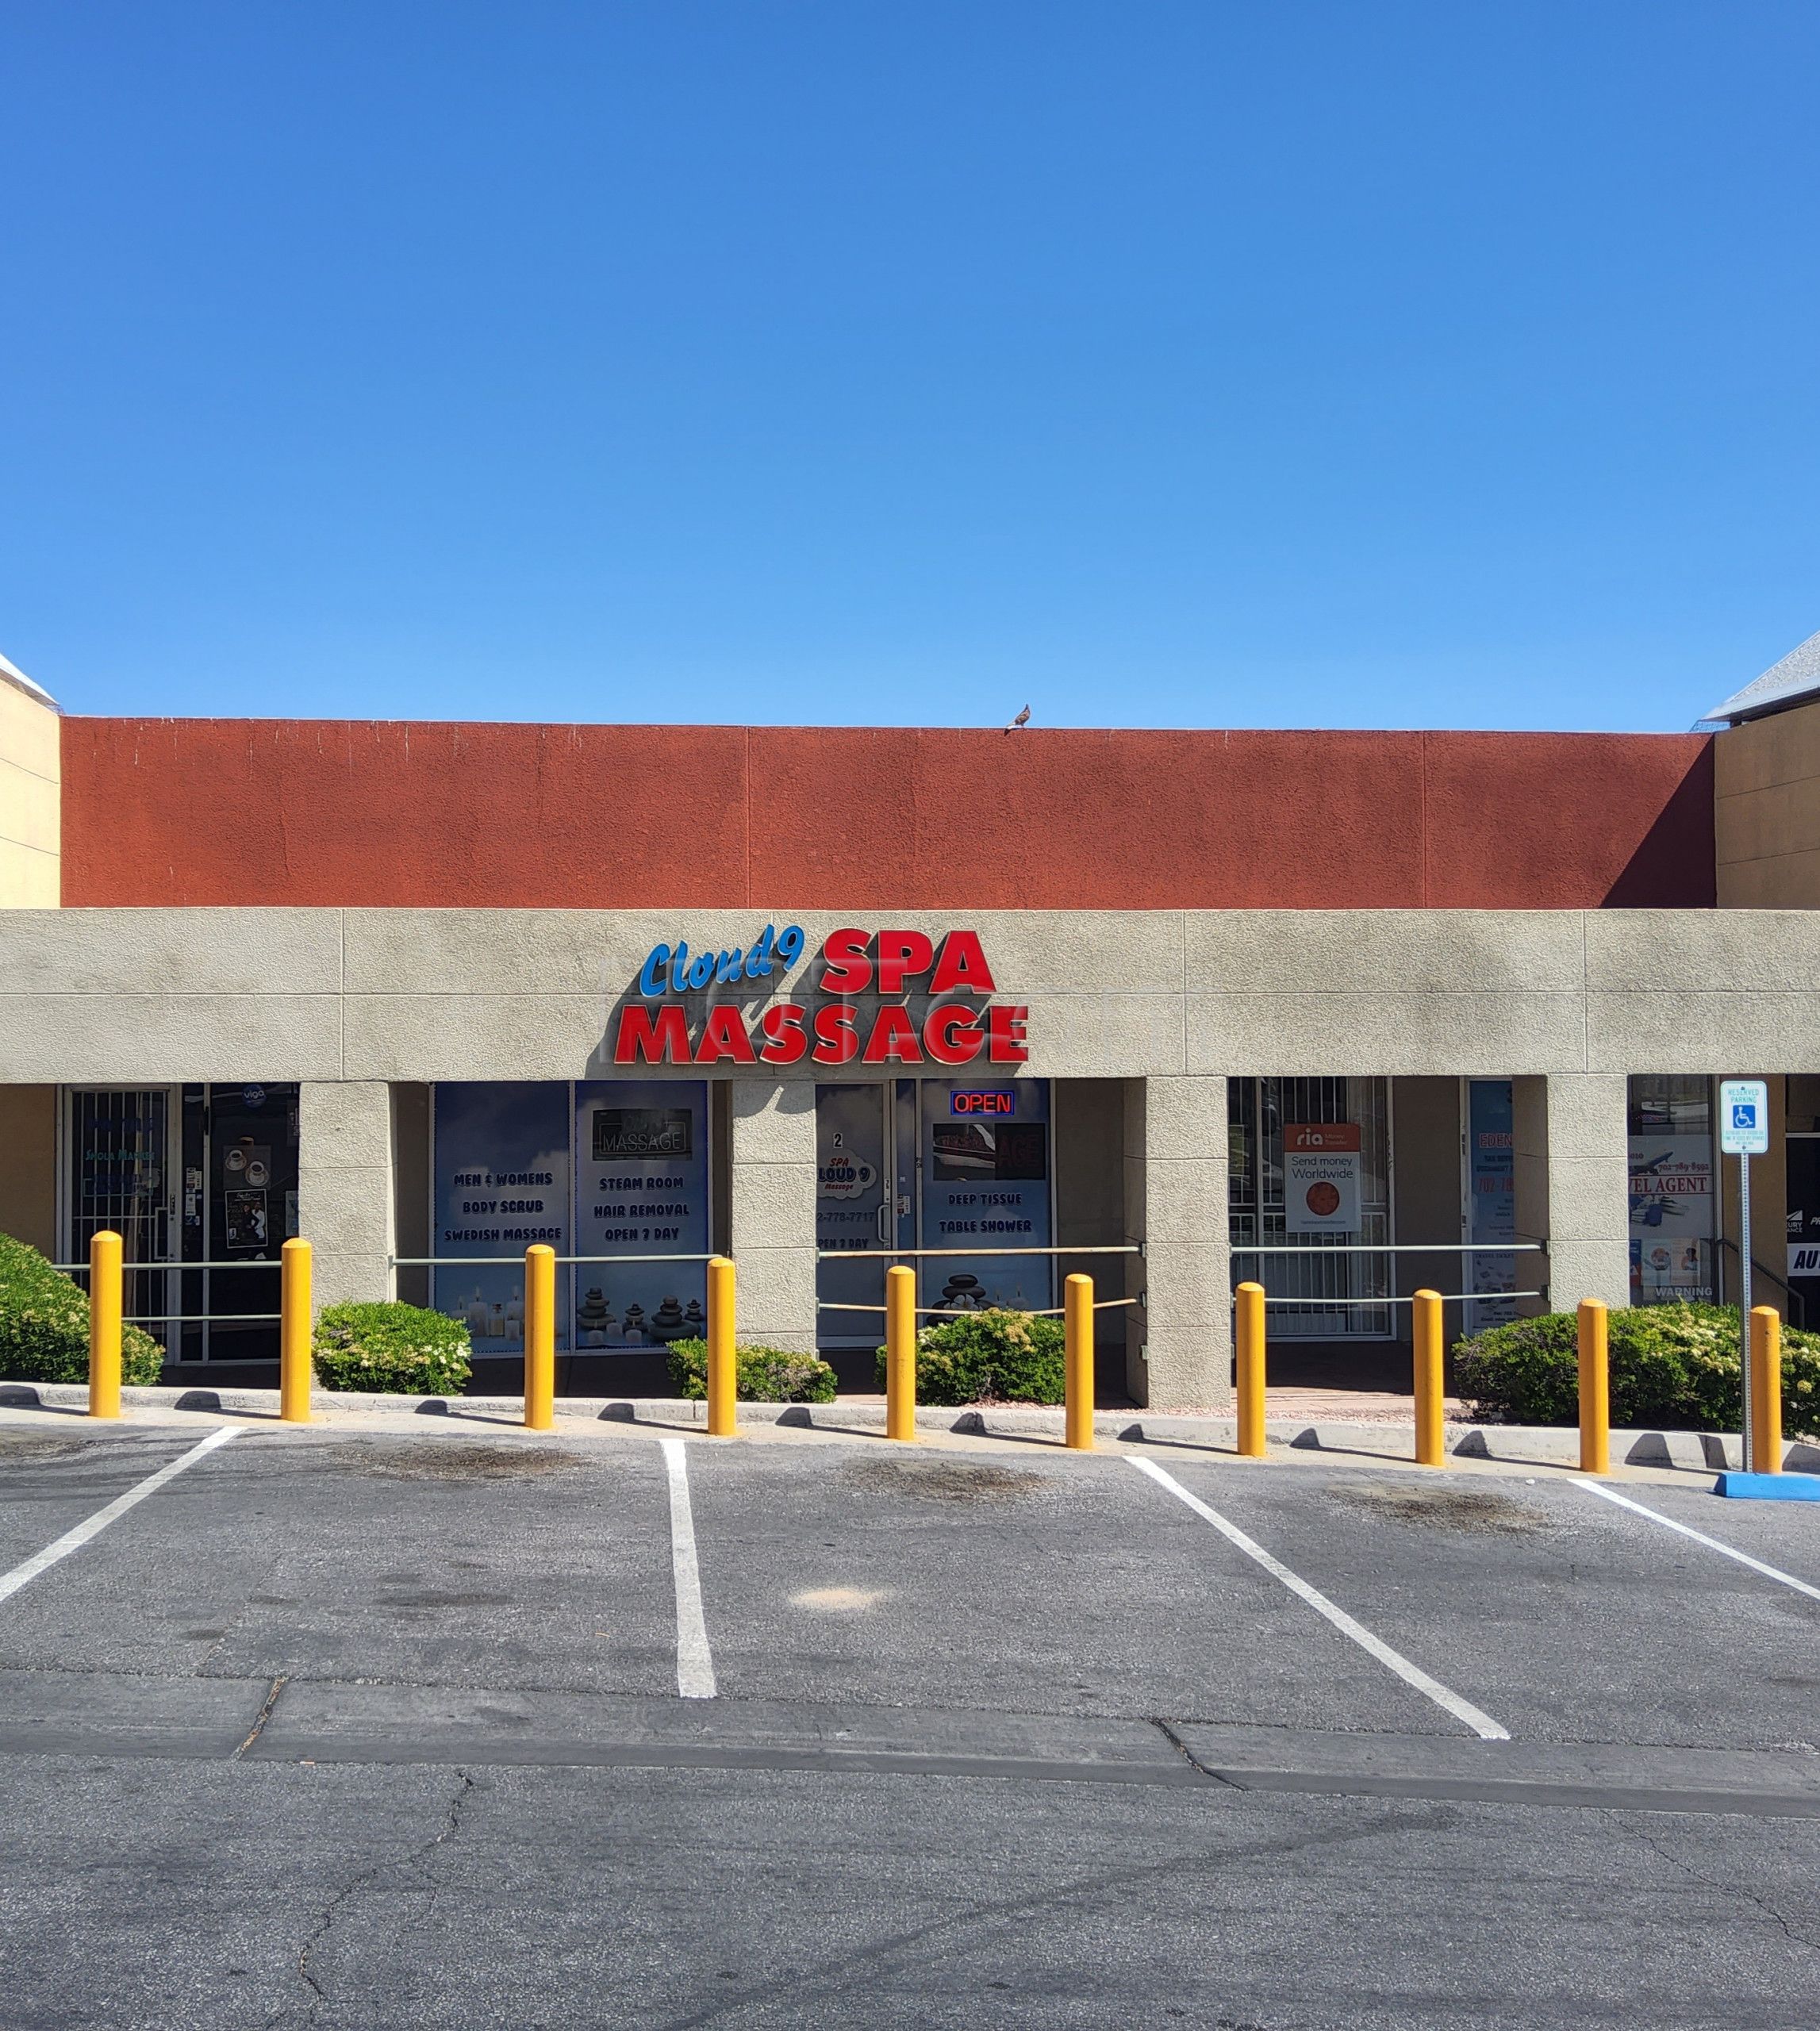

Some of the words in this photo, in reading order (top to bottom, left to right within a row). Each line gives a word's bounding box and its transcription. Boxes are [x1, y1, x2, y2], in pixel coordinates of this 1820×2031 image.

[820, 927, 997, 994] SPA
[614, 1004, 1030, 1065] MASSAGE
[954, 1094, 1012, 1112] OPEN
[602, 1132, 682, 1152] MASSAGE
[834, 1134, 842, 1147] 2
[1297, 1127, 1323, 1145] ria
[829, 1158, 849, 1166] SPA
[1292, 1156, 1317, 1165] Send
[1319, 1158, 1353, 1166] money
[455, 1173, 481, 1185] MEN
[496, 1172, 553, 1185] WOMENS
[817, 1167, 857, 1181] LOUD
[858, 1167, 871, 1182] 9
[1292, 1169, 1353, 1179] Worldwide
[599, 1177, 643, 1190] STEAM
[646, 1176, 684, 1189] ROOM
[1656, 1177, 1707, 1192] AGENT
[949, 1193, 977, 1205] DEEP
[981, 1192, 1022, 1205] TISSUE
[463, 1200, 497, 1214] BODY
[500, 1200, 543, 1214] SCRUB
[594, 1204, 626, 1218] HAIR
[629, 1203, 689, 1218] REMOVAL
[817, 1211, 874, 1222] 2-778-7717
[939, 1219, 977, 1233] TABLE
[981, 1219, 1032, 1233] SHOWER
[444, 1228, 500, 1242] SWEDISH
[503, 1227, 562, 1242] MASSAGE
[605, 1227, 638, 1242] OPEN
[654, 1227, 680, 1241] DAY
[817, 1238, 837, 1250] PEN
[1793, 1250, 1820, 1269] AU
[1656, 1287, 1713, 1296] WARNING
